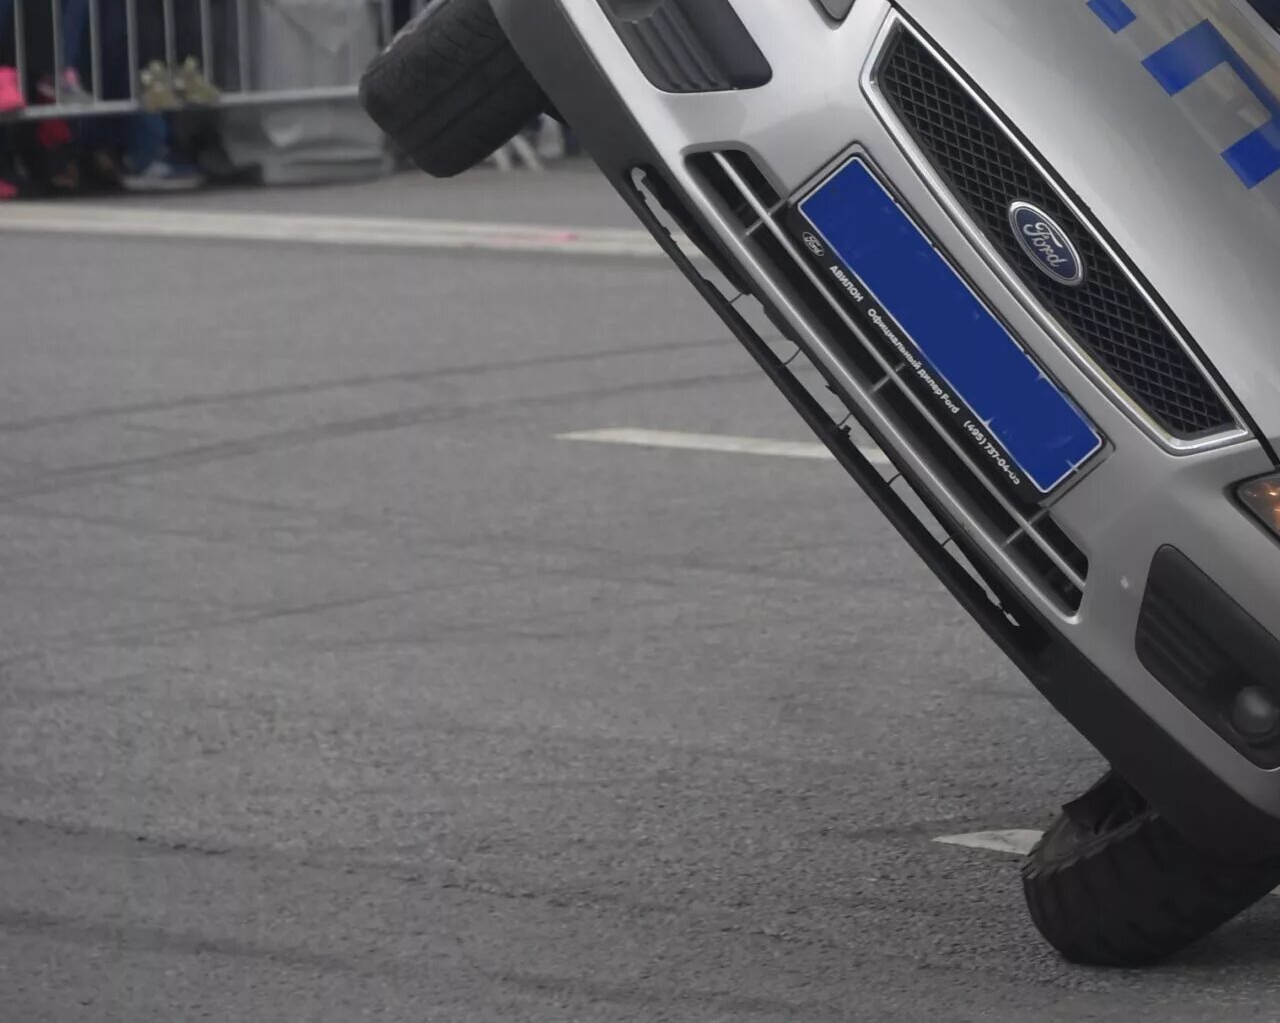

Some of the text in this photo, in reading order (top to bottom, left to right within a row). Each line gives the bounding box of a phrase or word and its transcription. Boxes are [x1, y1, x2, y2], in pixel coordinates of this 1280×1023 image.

[804, 236, 823, 254] Ford
[1022, 221, 1068, 268] Ford
[829, 265, 864, 302] АВИЛОН
[867, 308, 960, 414] Официальный дилер Ford
[963, 420, 987, 445] (495)
